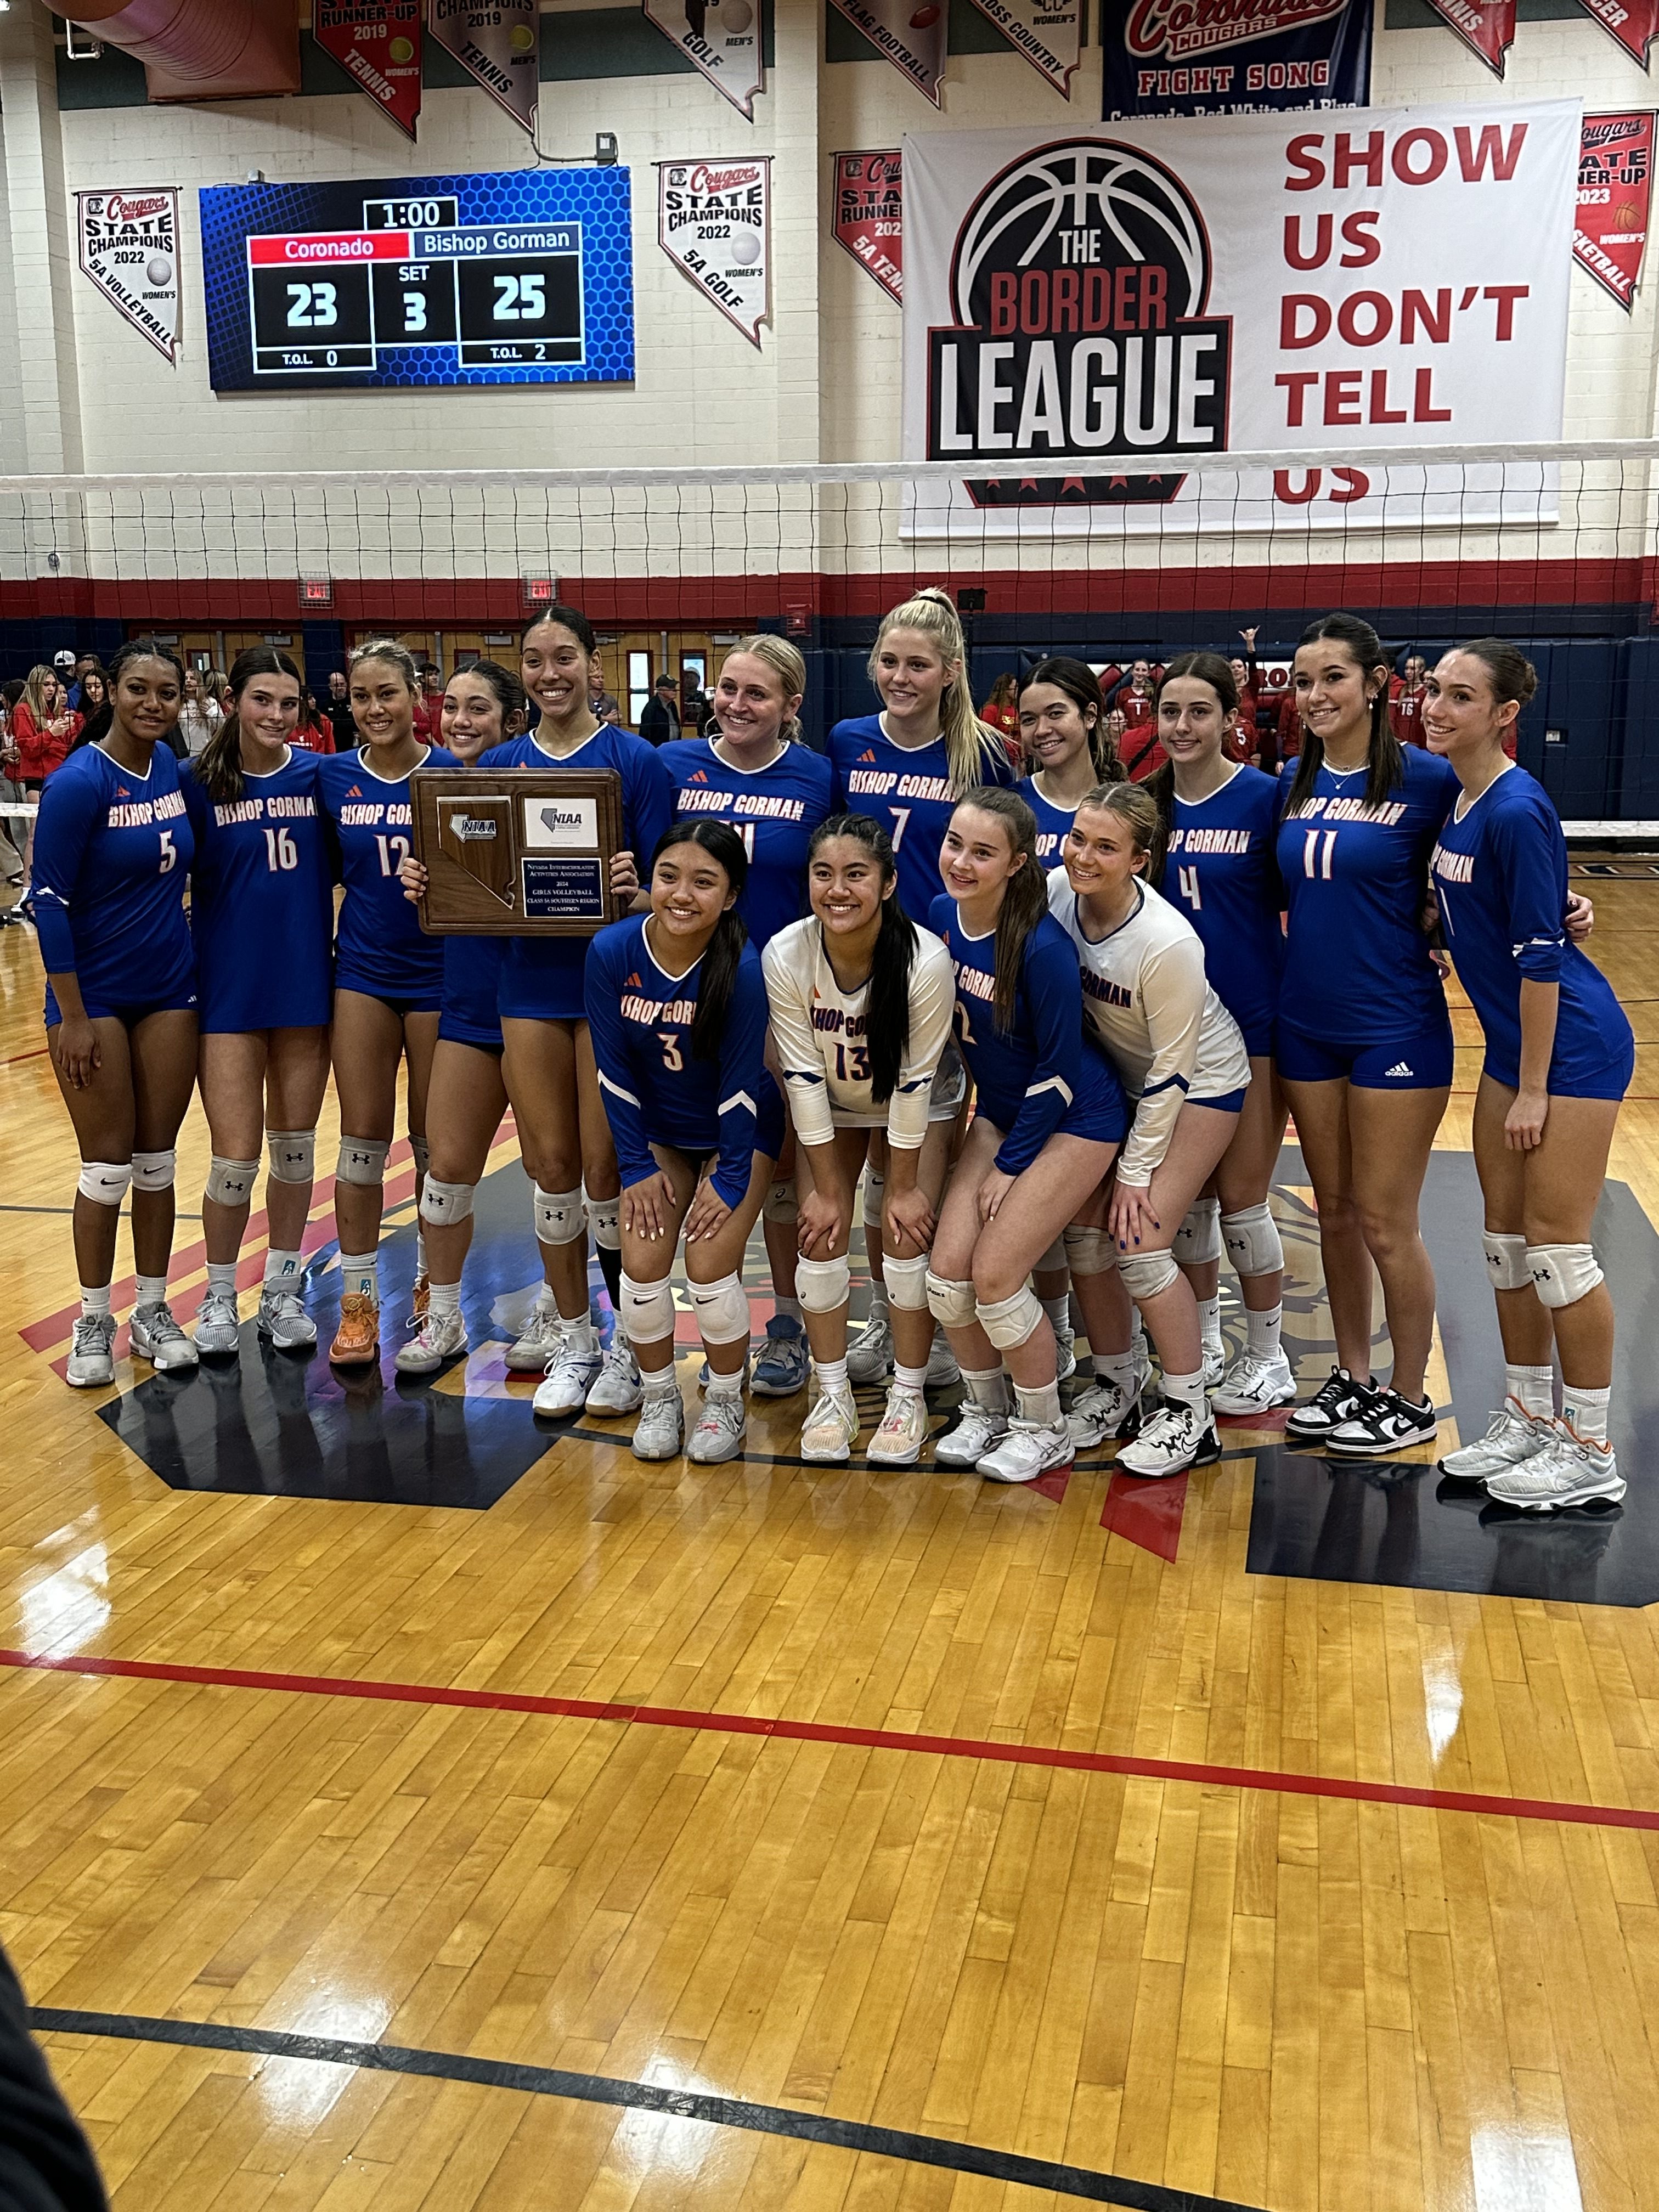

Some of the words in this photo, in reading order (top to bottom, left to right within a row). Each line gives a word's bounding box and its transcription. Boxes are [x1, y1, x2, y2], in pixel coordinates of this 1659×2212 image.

[320, 4, 417, 29] RUNNER-UP
[467, 11, 501, 27] 2019
[1033, 14, 1076, 25] WOMEN'S
[354, 24, 387, 40] 2019
[725, 37, 753, 46] MEN'S
[1176, 17, 1278, 52] COUGARS
[510, 55, 536, 65] MEN'S
[682, 31, 724, 67] GOLF
[872, 25, 929, 82] FOOTBALL
[1008, 21, 1064, 73] COUNTRY
[344, 48, 396, 101] TENNIS
[385, 67, 419, 76] WOMEN'S
[460, 41, 513, 93] TENNIS
[1138, 66, 1234, 97] FIGHT
[1246, 59, 1329, 91] SONG
[1582, 119, 1646, 149] ougars
[1284, 123, 1529, 191] SHOW
[1579, 147, 1647, 169] ATE
[690, 166, 760, 194] Cougars
[107, 195, 169, 222] Cougars
[666, 184, 763, 210] STATE
[842, 189, 901, 205] STA
[86, 212, 173, 236] STATE
[382, 203, 439, 228] 1:00
[668, 208, 762, 232] CHAMPIONS
[842, 204, 901, 224] RUNNE
[424, 232, 487, 255] Bishop
[493, 230, 570, 251] Gorman
[697, 225, 731, 239] 2022
[874, 222, 902, 237] 202
[1284, 211, 1381, 270] US
[1599, 233, 1645, 245] WOMEN'S
[88, 235, 173, 257] CHAMPIONS
[114, 251, 145, 264] 2022
[285, 240, 374, 259] Coronado
[853, 235, 877, 261] 5A
[1058, 229, 1101, 264] THE
[399, 266, 430, 281] SET
[684, 249, 707, 273] 5A
[704, 272, 744, 307] GOLF
[725, 268, 763, 278] WOMEN'S
[89, 259, 107, 278] 5A
[105, 274, 171, 344] VOLLEYBALL
[142, 291, 176, 300] WOMEN'S
[286, 283, 338, 326] 23
[493, 274, 546, 320] 25
[990, 265, 1168, 336] BORDER
[404, 292, 427, 331] 3
[1279, 285, 1530, 349] DON'T
[282, 354, 313, 365] T.O.L.
[326, 350, 338, 367] 0
[490, 347, 522, 359] T.O.L.
[534, 344, 546, 360] 2
[940, 334, 1217, 450] LEAGUE
[1274, 368, 1452, 427] TELL
[1273, 467, 1370, 504] US
[1135, 703, 1141, 715] 1
[1401, 703, 1414, 716] 16
[1235, 727, 1246, 745] 5
[849, 770, 898, 795] BISHOP
[108, 802, 153, 827] BISHOP
[214, 798, 263, 827] BISHOP
[340, 804, 385, 825] BISHOP
[386, 804, 412, 825] GOR
[676, 788, 733, 811] BISHOP
[733, 794, 805, 821] GORMAN
[1323, 797, 1408, 826] GORMAN
[463, 821, 495, 832] NIAA
[553, 813, 582, 824] NIAA
[888, 806, 912, 853] 7
[159, 830, 177, 873] 5
[261, 826, 298, 872] 16
[1184, 829, 1251, 853] GORMAN
[373, 833, 409, 877] 12
[1304, 829, 1338, 880] 11
[1178, 864, 1202, 911] 4
[1080, 966, 1131, 1008] GORMAN
[621, 995, 663, 1025] ISHOP
[656, 1033, 684, 1071] 3
[831, 1042, 872, 1081] 13
